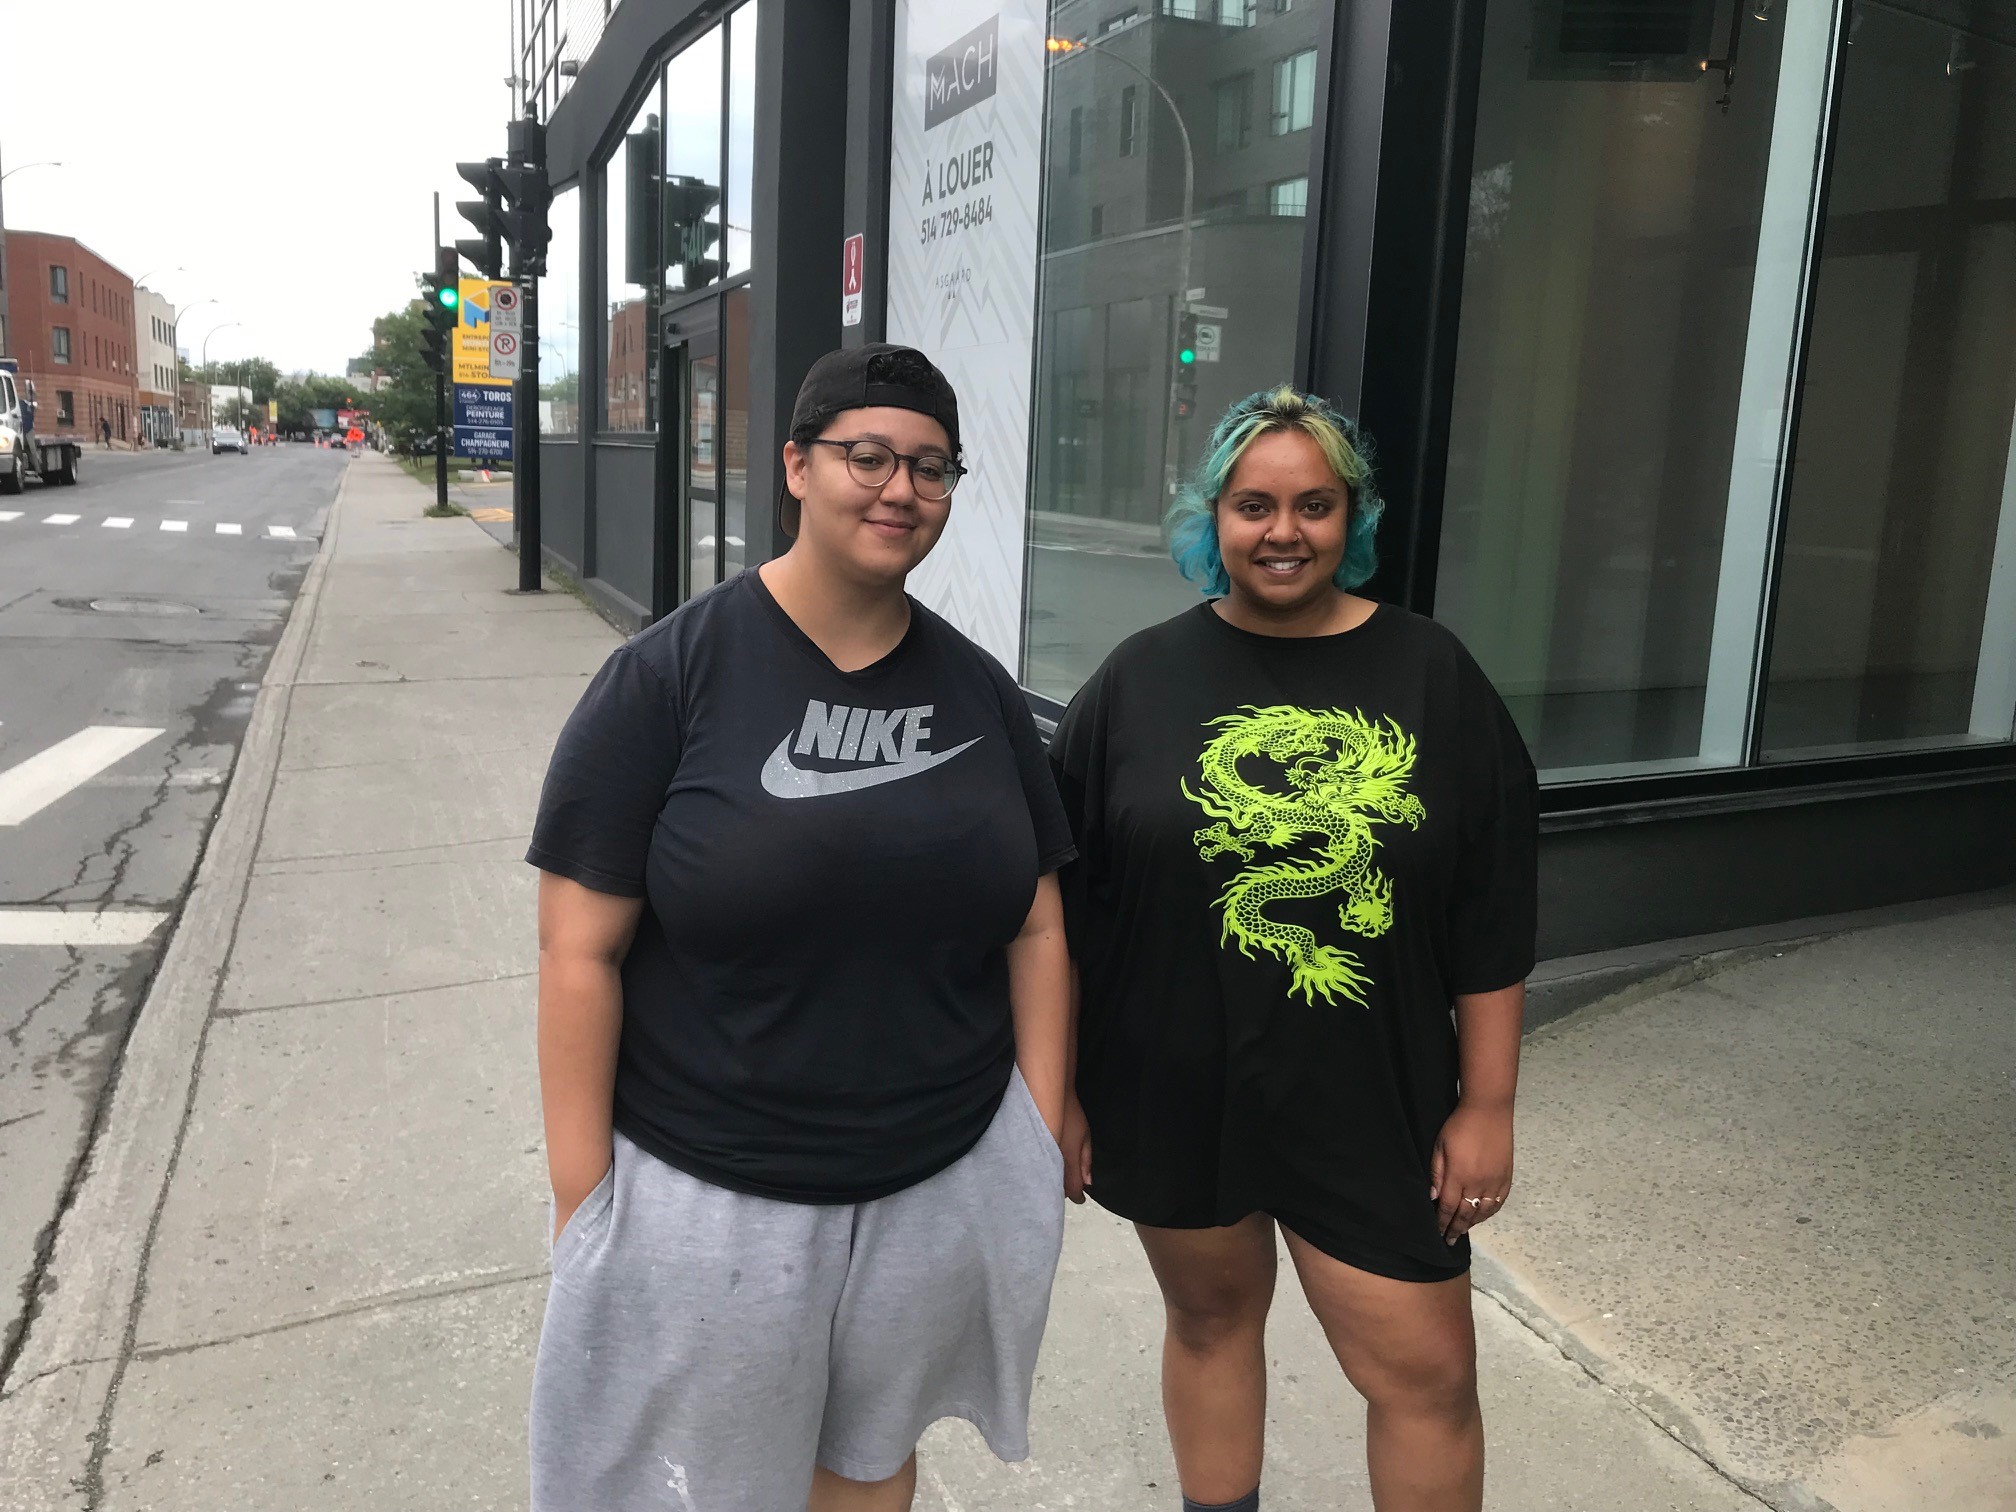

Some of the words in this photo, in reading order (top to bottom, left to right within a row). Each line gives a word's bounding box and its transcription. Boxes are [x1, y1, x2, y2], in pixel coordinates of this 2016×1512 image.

[930, 33, 993, 111] MACH
[922, 159, 933, 207] À
[938, 140, 994, 200] LOUER
[921, 215, 936, 245] 514
[941, 195, 992, 238] 729-8484
[461, 391, 478, 400] 464
[483, 390, 512, 402] TOROS
[466, 409, 505, 419] PEINTURE
[461, 438, 510, 449] CHAMPAGNEUR
[474, 431, 497, 439] GARAGE
[794, 698, 934, 763] NIKE
